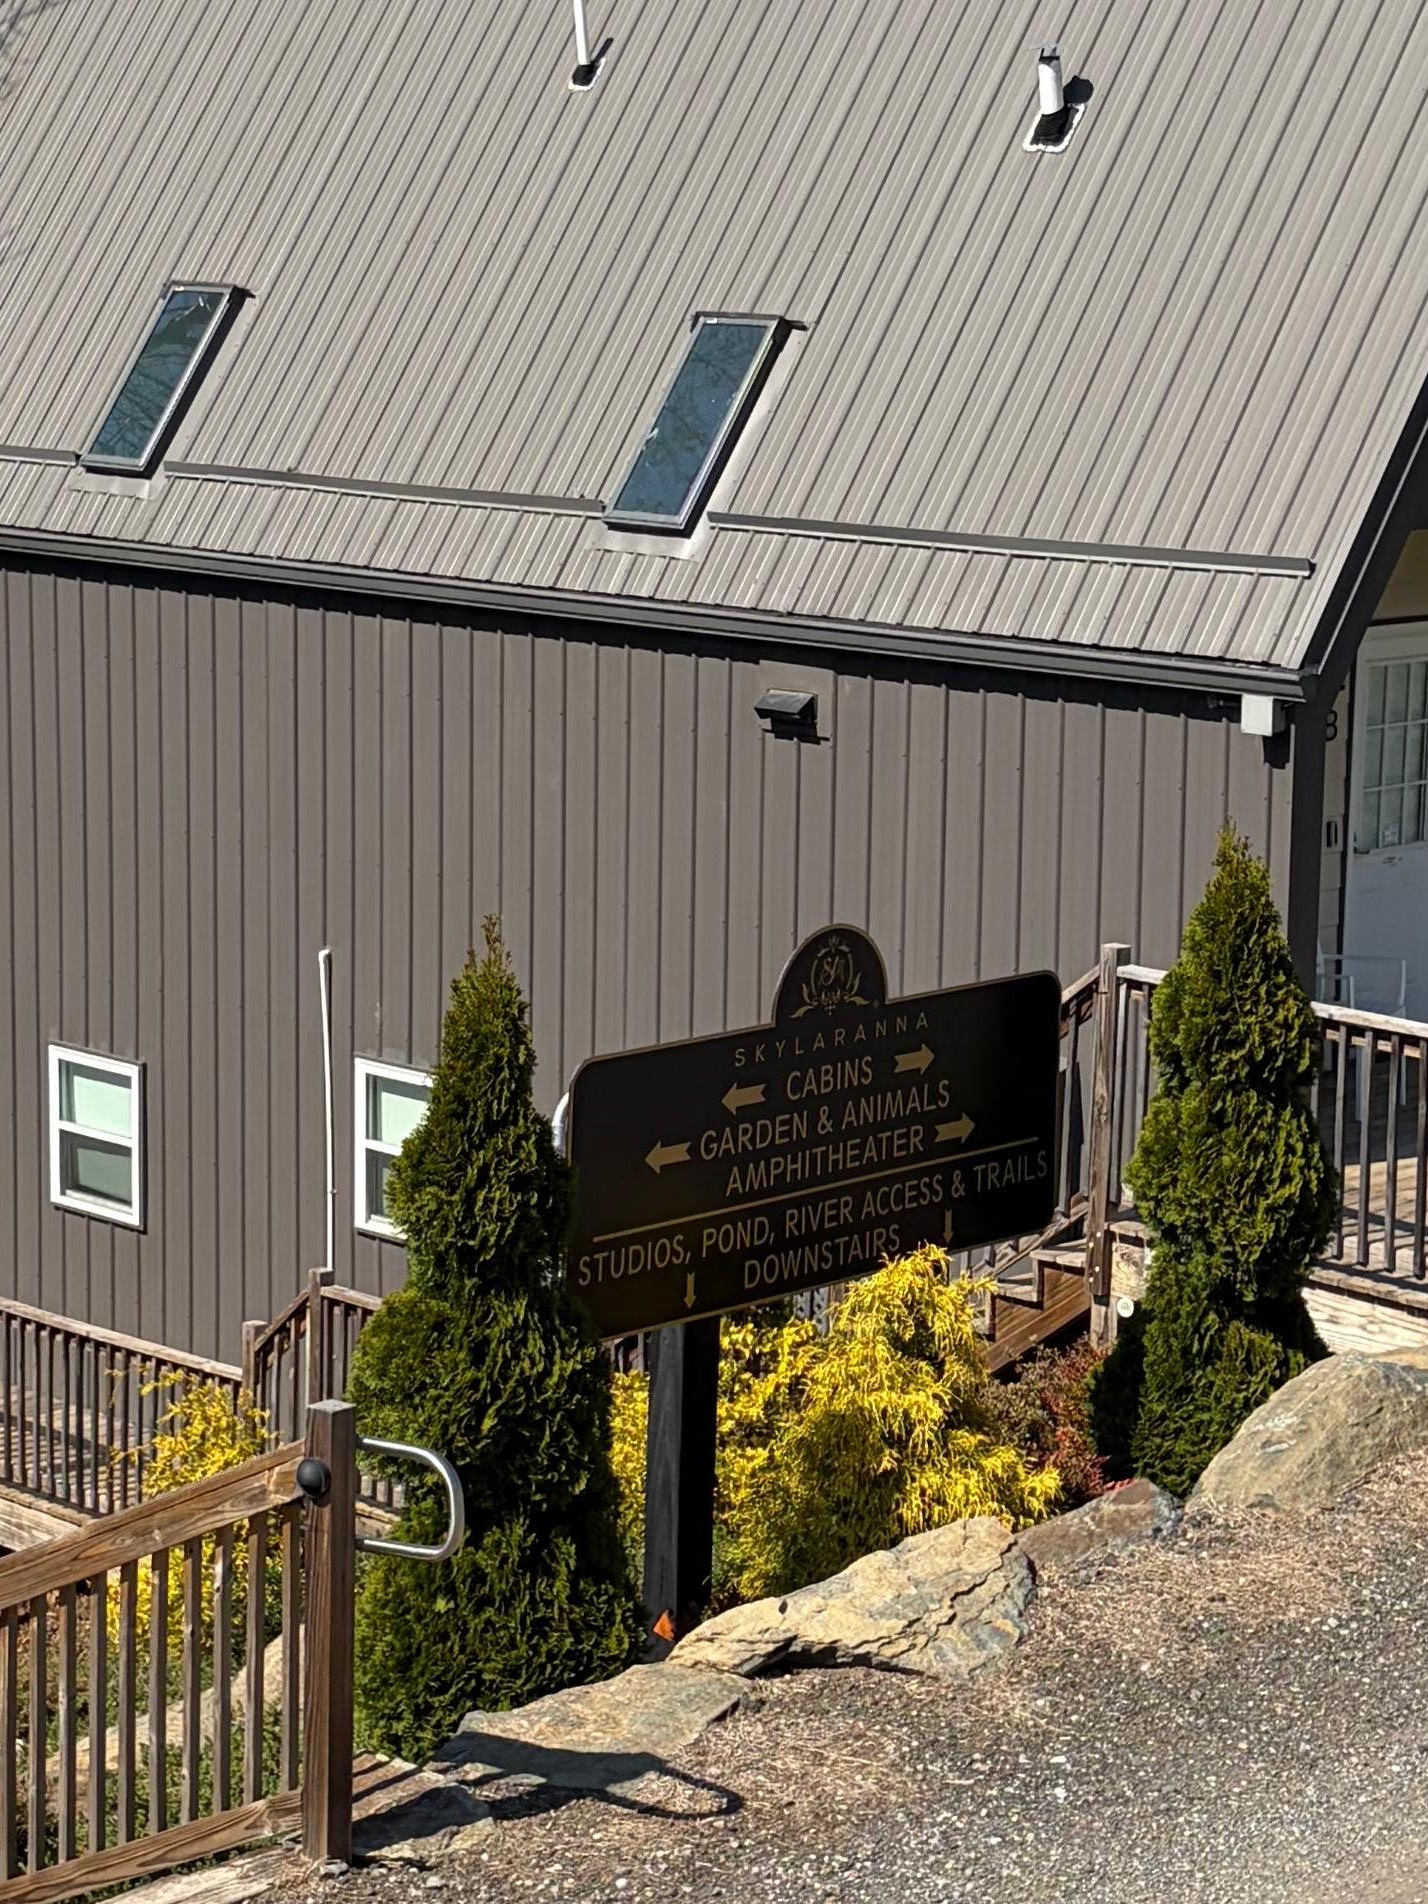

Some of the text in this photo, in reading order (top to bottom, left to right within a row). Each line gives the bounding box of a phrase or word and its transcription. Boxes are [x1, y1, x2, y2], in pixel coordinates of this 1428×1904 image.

[734, 1012, 929, 1067] SKYLARANNA
[786, 1056, 873, 1100] CABINS
[700, 1079, 950, 1160] GARDEN & ANIMALS
[726, 1125, 925, 1197] AMPHITHEATER
[578, 1150, 1048, 1286] STUDIOS, POND, RIVER ACCESS & TRAILS
[744, 1223, 901, 1289] DOWNSTAIRS
